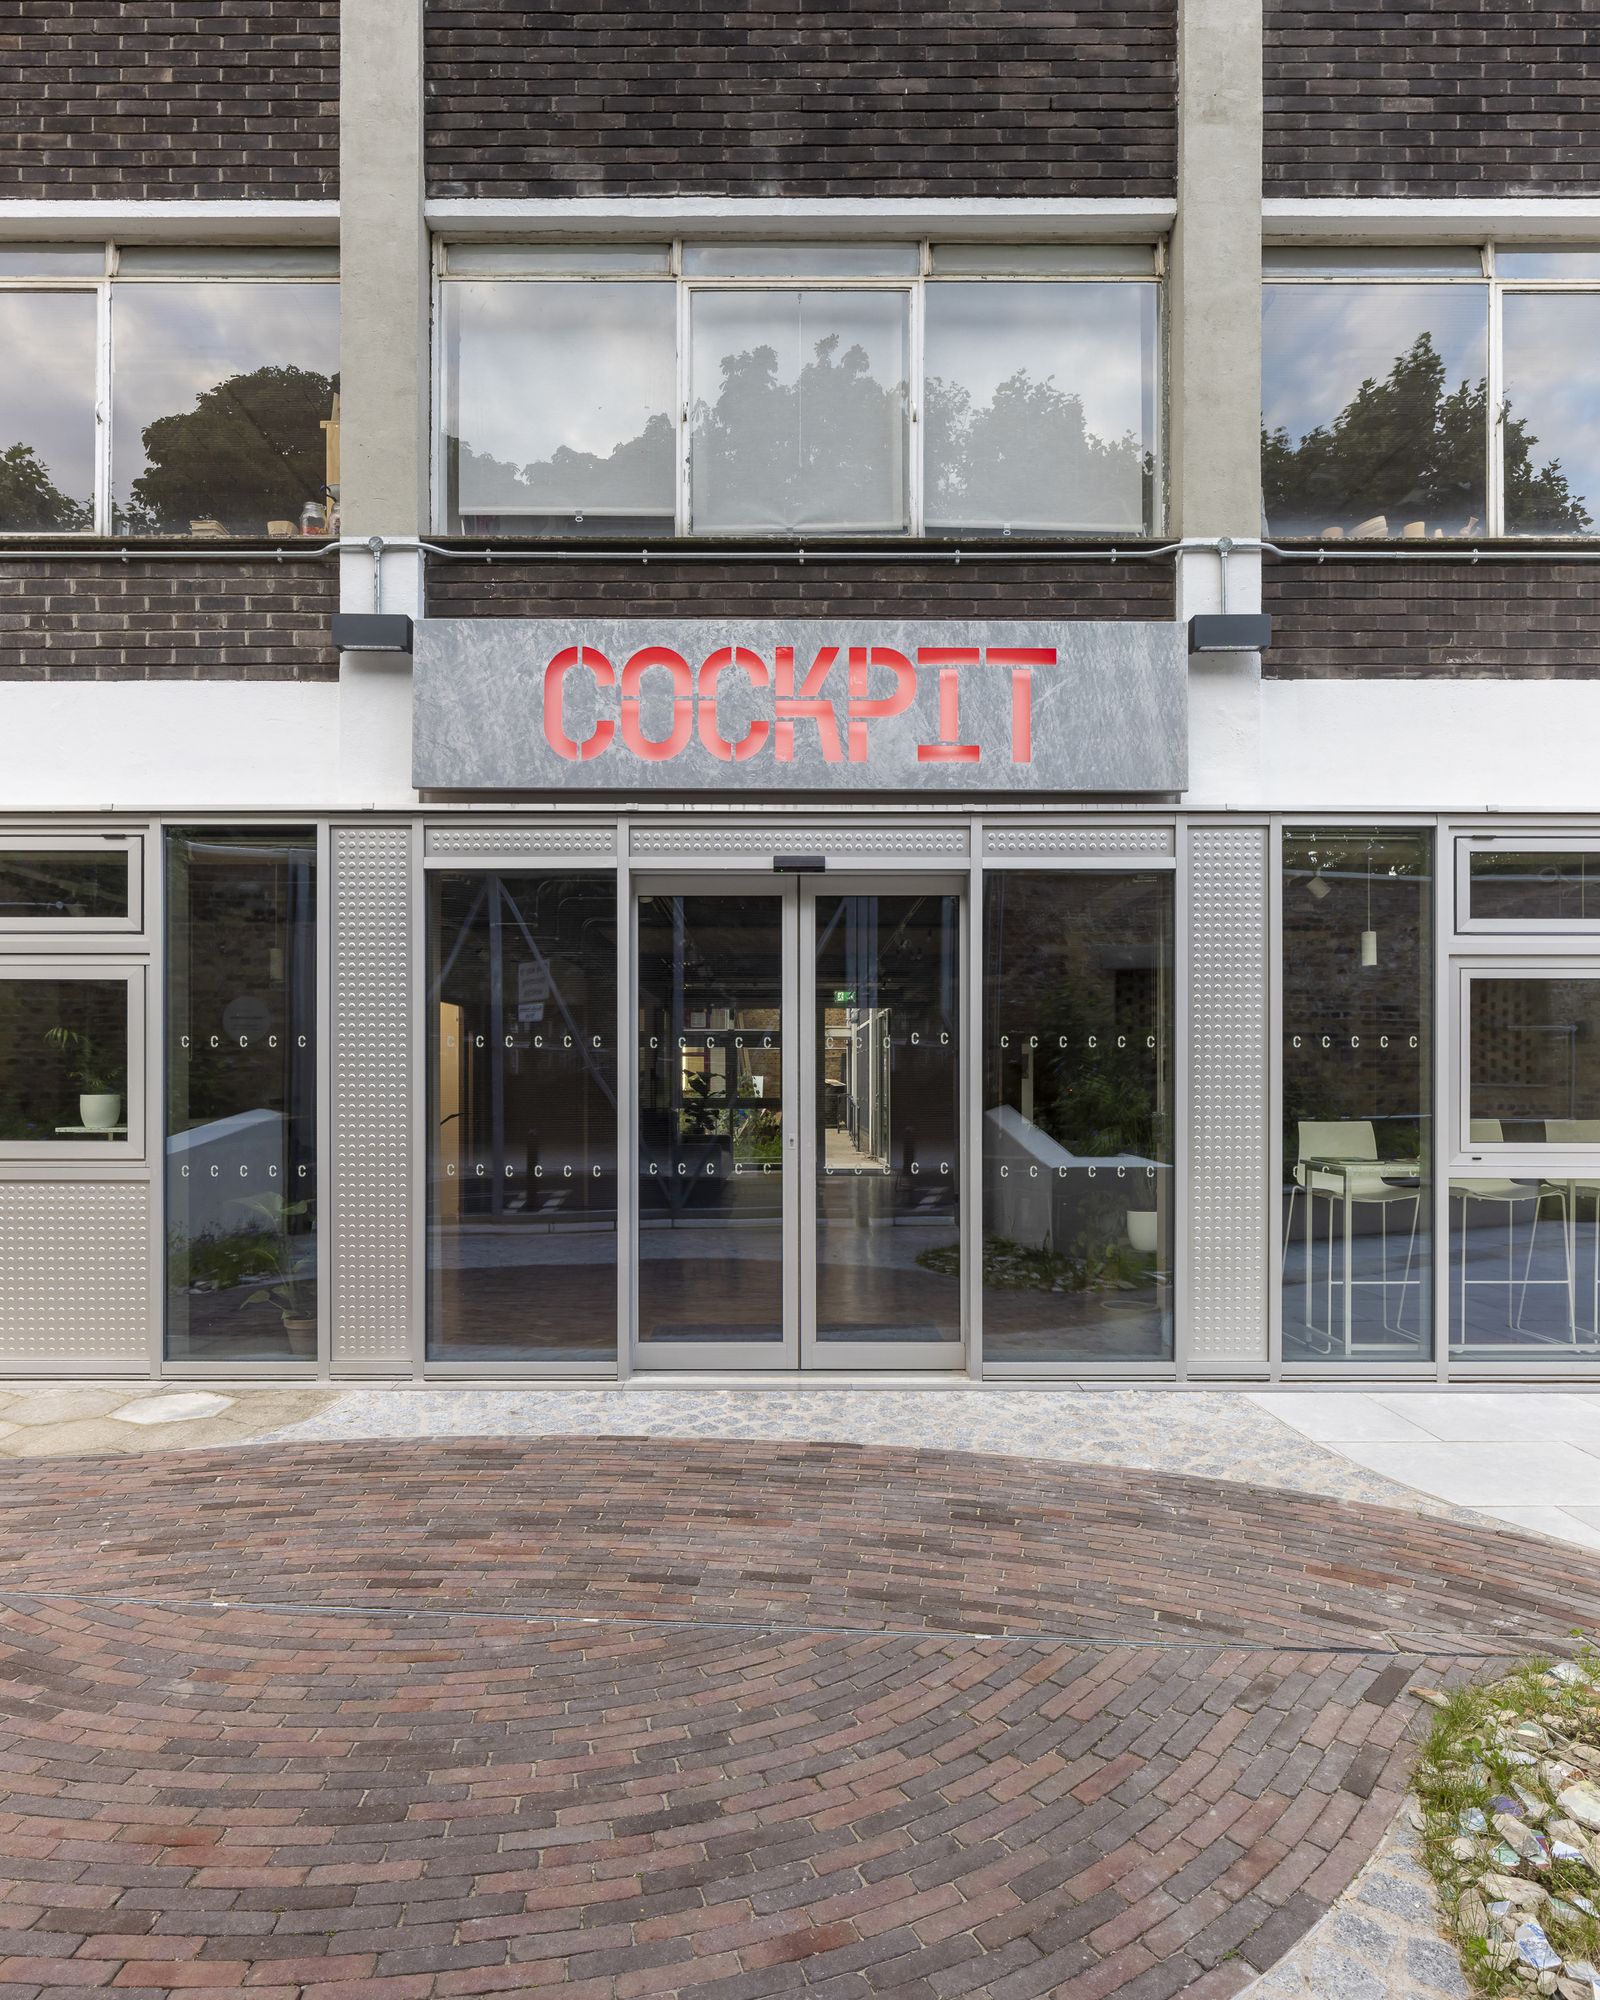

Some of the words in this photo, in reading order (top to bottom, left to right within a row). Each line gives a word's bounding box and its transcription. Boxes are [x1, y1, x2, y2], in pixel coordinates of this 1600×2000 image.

[544, 646, 1057, 763] COCKPIT
[181, 1035, 190, 1047] C
[210, 1035, 219, 1047] C
[239, 1035, 248, 1047] C
[269, 1035, 277, 1047] C
[298, 1035, 306, 1047] C
[476, 1035, 484, 1047] C
[505, 1035, 513, 1047] C
[534, 1035, 543, 1047] C
[564, 1035, 572, 1047] C
[593, 1035, 601, 1047] C
[649, 1037, 658, 1049] C
[678, 1037, 686, 1049] C
[706, 1037, 715, 1049] C
[735, 1037, 743, 1049] C
[763, 1037, 772, 1049] C
[911, 1032, 919, 1044] C
[940, 1032, 949, 1044] C
[1000, 1036, 1009, 1048] C
[1030, 1036, 1038, 1048] C
[1059, 1036, 1067, 1048] C
[1088, 1036, 1097, 1048] C
[1117, 1036, 1126, 1048] C
[1147, 1036, 1155, 1048] C
[1293, 1036, 1301, 1048] C
[1322, 1036, 1330, 1048] C
[1351, 1036, 1360, 1048] C
[1380, 1036, 1389, 1048] C
[1409, 1036, 1418, 1048] C
[181, 1165, 190, 1177] C
[210, 1165, 219, 1177] C
[239, 1165, 248, 1177] C
[269, 1165, 277, 1177] C
[298, 1165, 306, 1177] C
[447, 1164, 455, 1176] C
[476, 1164, 484, 1176] C
[505, 1165, 513, 1177] C
[534, 1165, 543, 1177] C
[564, 1165, 572, 1177] C
[593, 1165, 601, 1177] C
[649, 1163, 658, 1175] C
[678, 1163, 686, 1175] C
[706, 1163, 714, 1175] C
[734, 1163, 743, 1175] C
[763, 1163, 772, 1175] C
[911, 1162, 919, 1174] C
[940, 1162, 948, 1174] C
[1000, 1166, 1009, 1178] C
[1029, 1166, 1038, 1178] C
[1059, 1166, 1067, 1178] C
[1088, 1166, 1096, 1178] C
[1117, 1166, 1126, 1178] C
[1146, 1166, 1155, 1178] C
